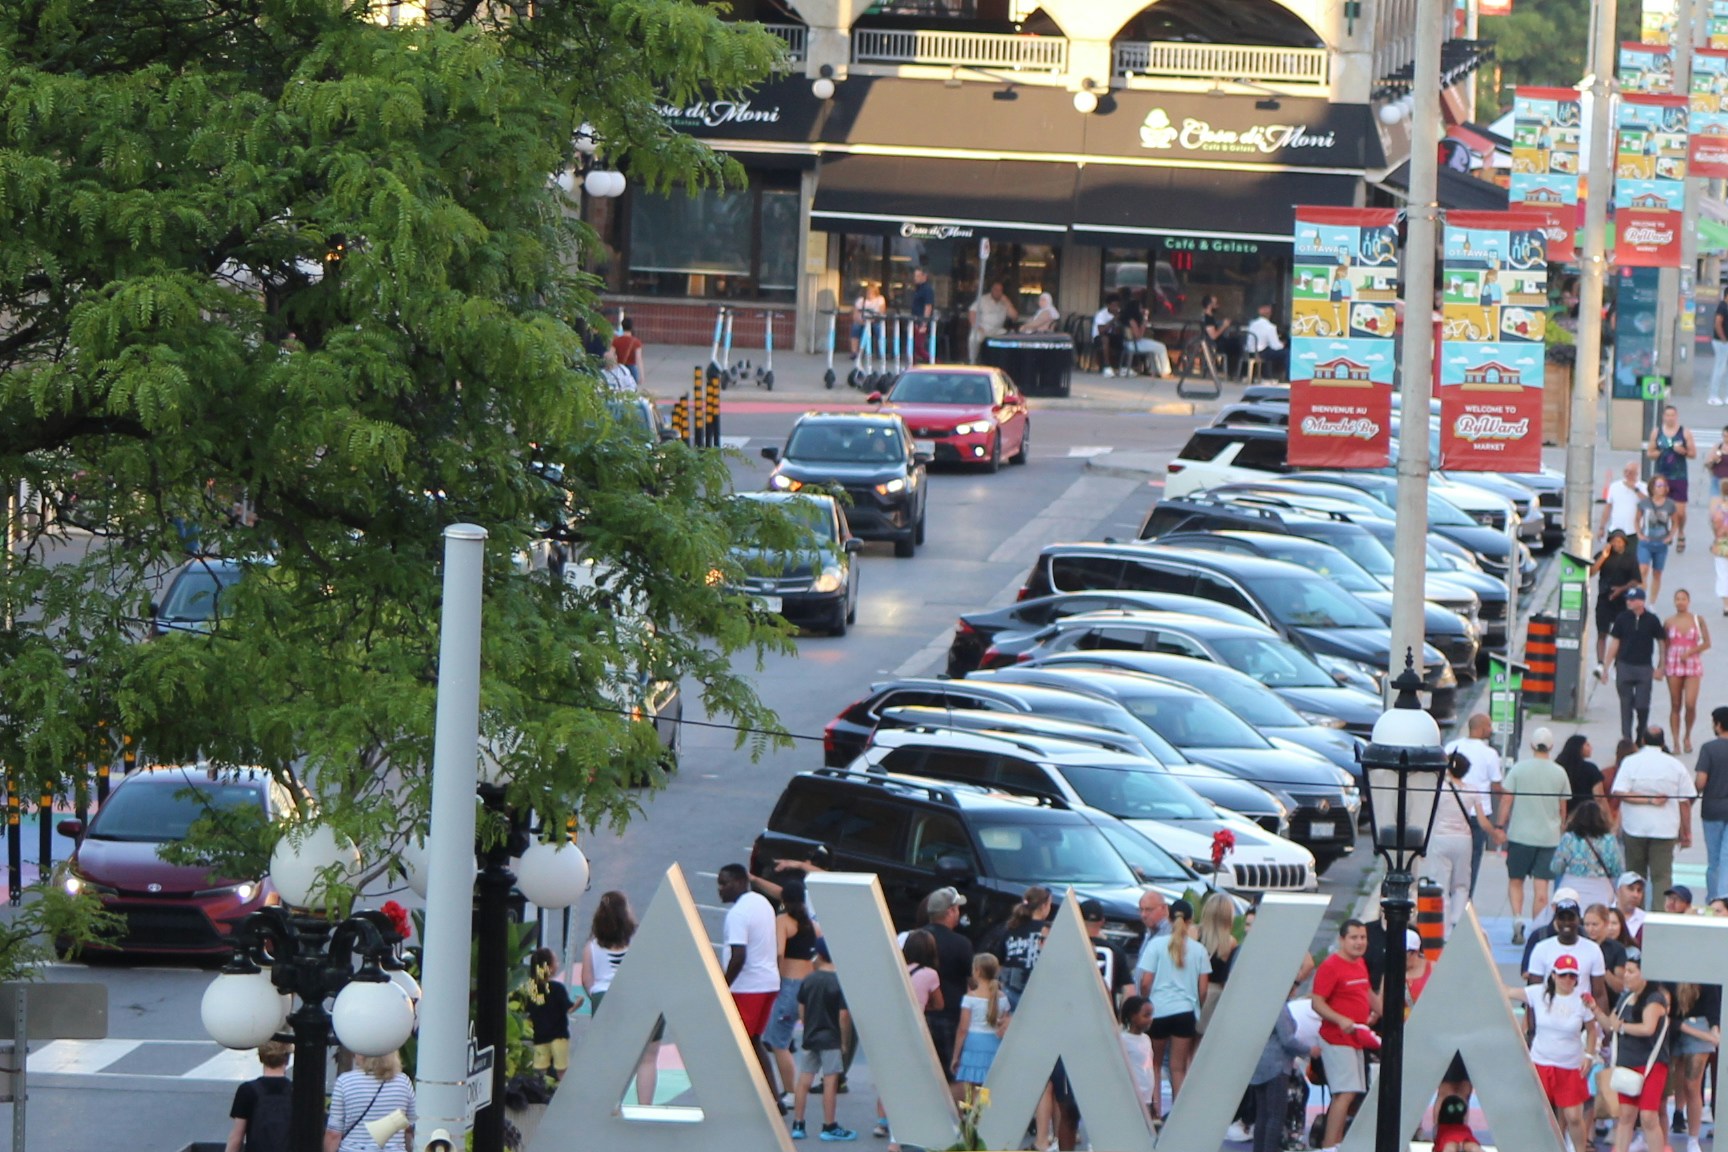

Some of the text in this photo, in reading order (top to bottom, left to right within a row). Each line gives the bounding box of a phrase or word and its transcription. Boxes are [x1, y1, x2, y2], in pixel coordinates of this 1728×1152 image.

[685, 102, 708, 118] di
[704, 100, 780, 127] Moni
[1179, 118, 1336, 153] Casa di Moni
[938, 226, 974, 239] Moni
[1625, 228, 1673, 244] ByWard
[1164, 237, 1258, 253] Café & Gelato
[1311, 405, 1368, 415] BIENVENUE AU
[1465, 404, 1517, 414] WELCOME TO
[1302, 416, 1379, 438] Marché By
[1458, 415, 1529, 437] ByWard
[1473, 443, 1505, 451] MARKET
